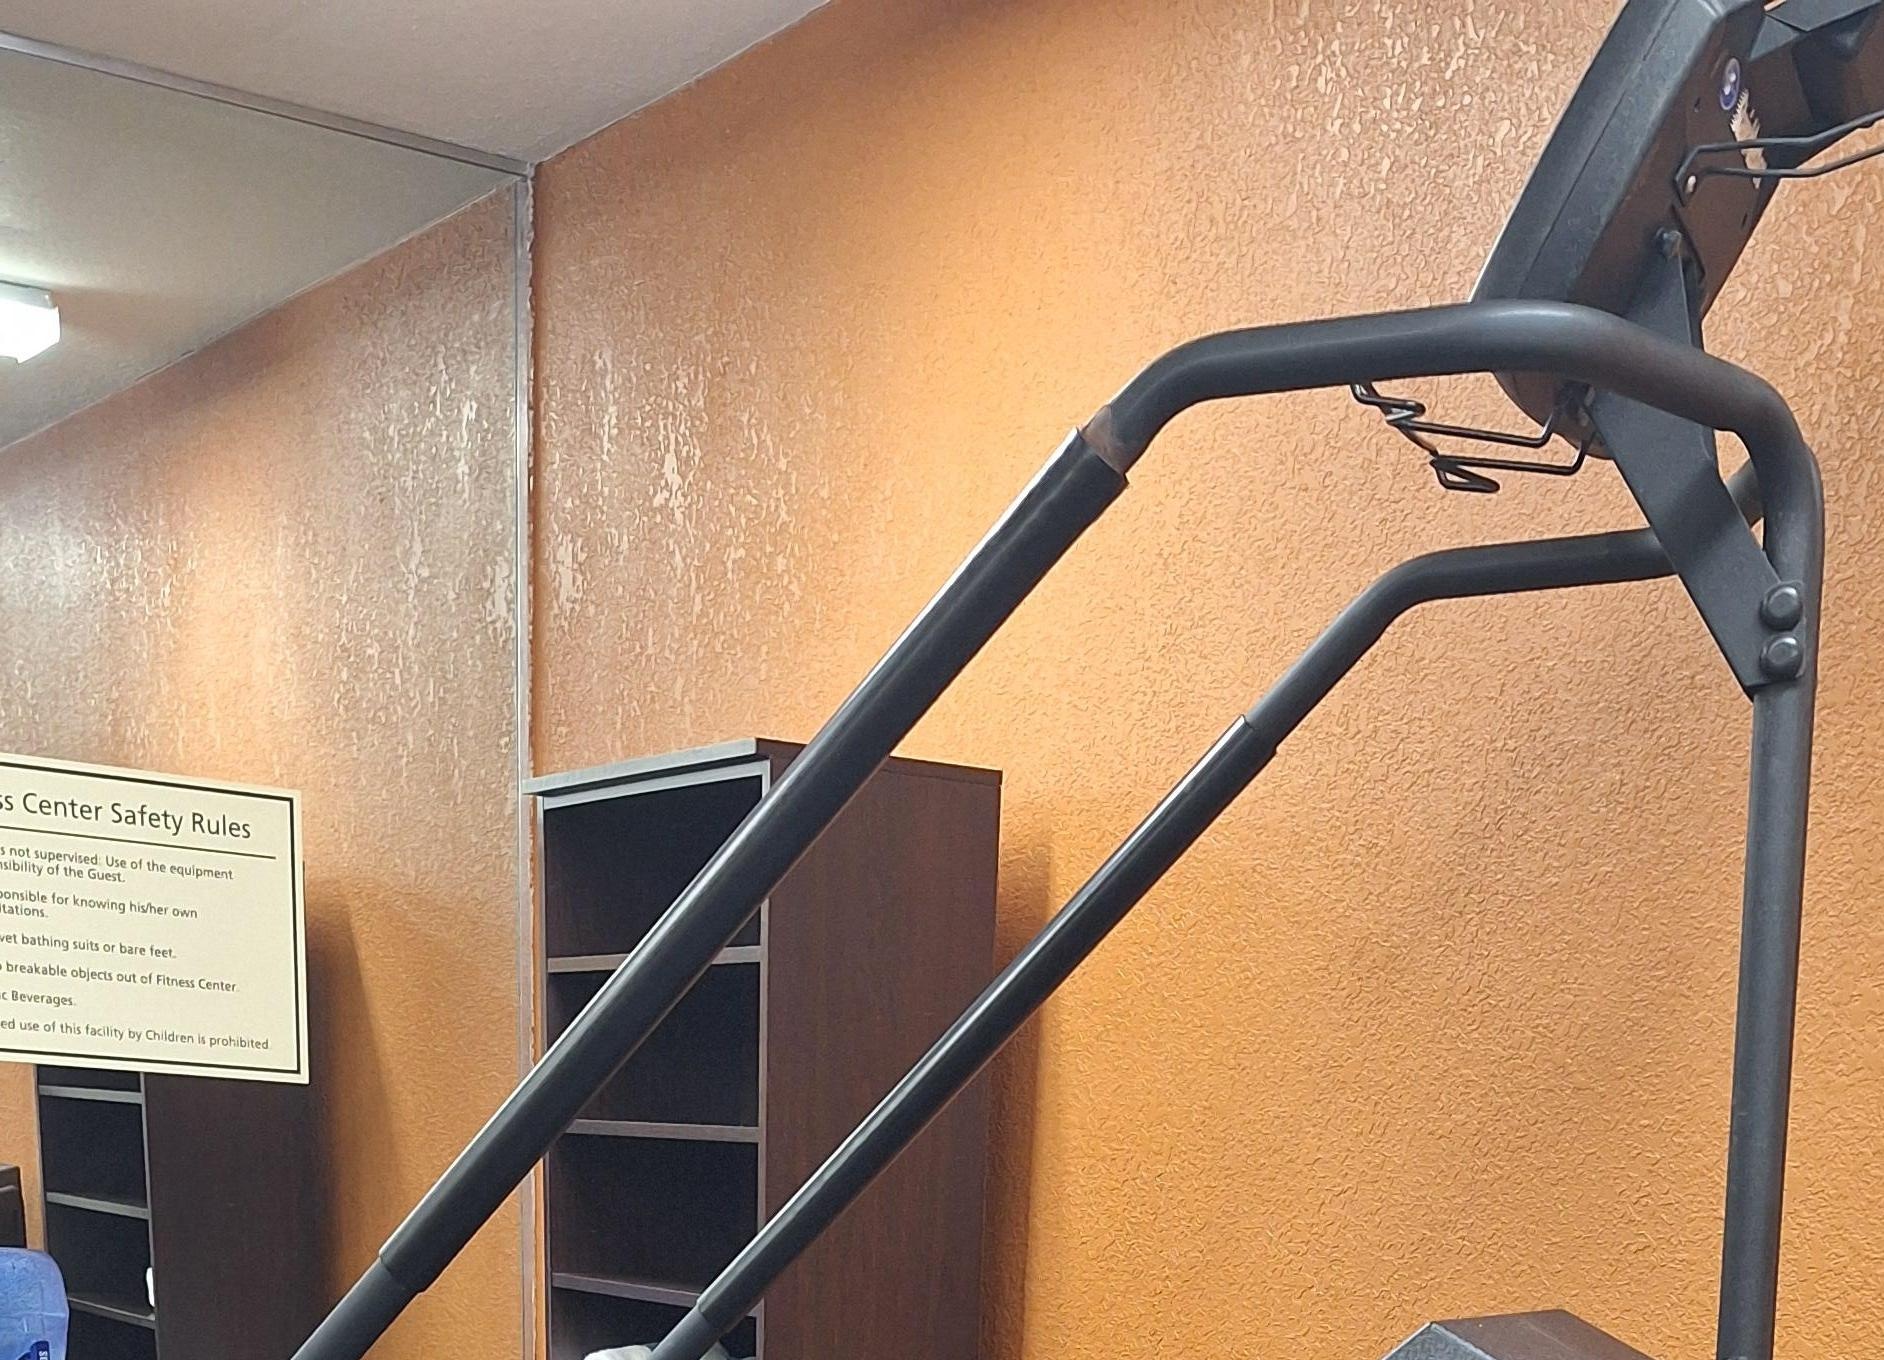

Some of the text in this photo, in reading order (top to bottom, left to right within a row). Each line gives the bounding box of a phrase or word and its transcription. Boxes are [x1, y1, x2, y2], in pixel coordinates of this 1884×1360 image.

[22, 792, 103, 821] Center
[111, 802, 183, 836] Safety
[191, 811, 251, 839] Rules
[9, 847, 30, 859] not
[105, 855, 127, 869] Use
[130, 858, 142, 870] of
[147, 860, 166, 873] the
[169, 864, 234, 880] equipment
[47, 864, 60, 876] of
[63, 865, 84, 879] the
[87, 868, 126, 883] Guest.
[52, 891, 69, 905] for
[73, 894, 126, 914] knowing
[129, 900, 168, 915] his/her
[172, 907, 198, 919] own
[21, 932, 69, 952] bathing
[72, 939, 100, 952] suits
[102, 943, 116, 953] or
[119, 942, 146, 956] bare
[149, 944, 177, 959] feet.
[6, 960, 67, 977] breakable
[70, 966, 113, 982] objects
[116, 972, 137, 984] out
[140, 972, 153, 985] of
[156, 974, 195, 989] Fitness
[11, 990, 76, 1008] Beverages.
[19, 1021, 40, 1031] use
[43, 1021, 56, 1033] of
[60, 1022, 82, 1035] this
[85, 1023, 124, 1041] facility
[128, 1027, 143, 1042] by
[145, 1029, 194, 1044] Children
[198, 1033, 206, 1045] is
